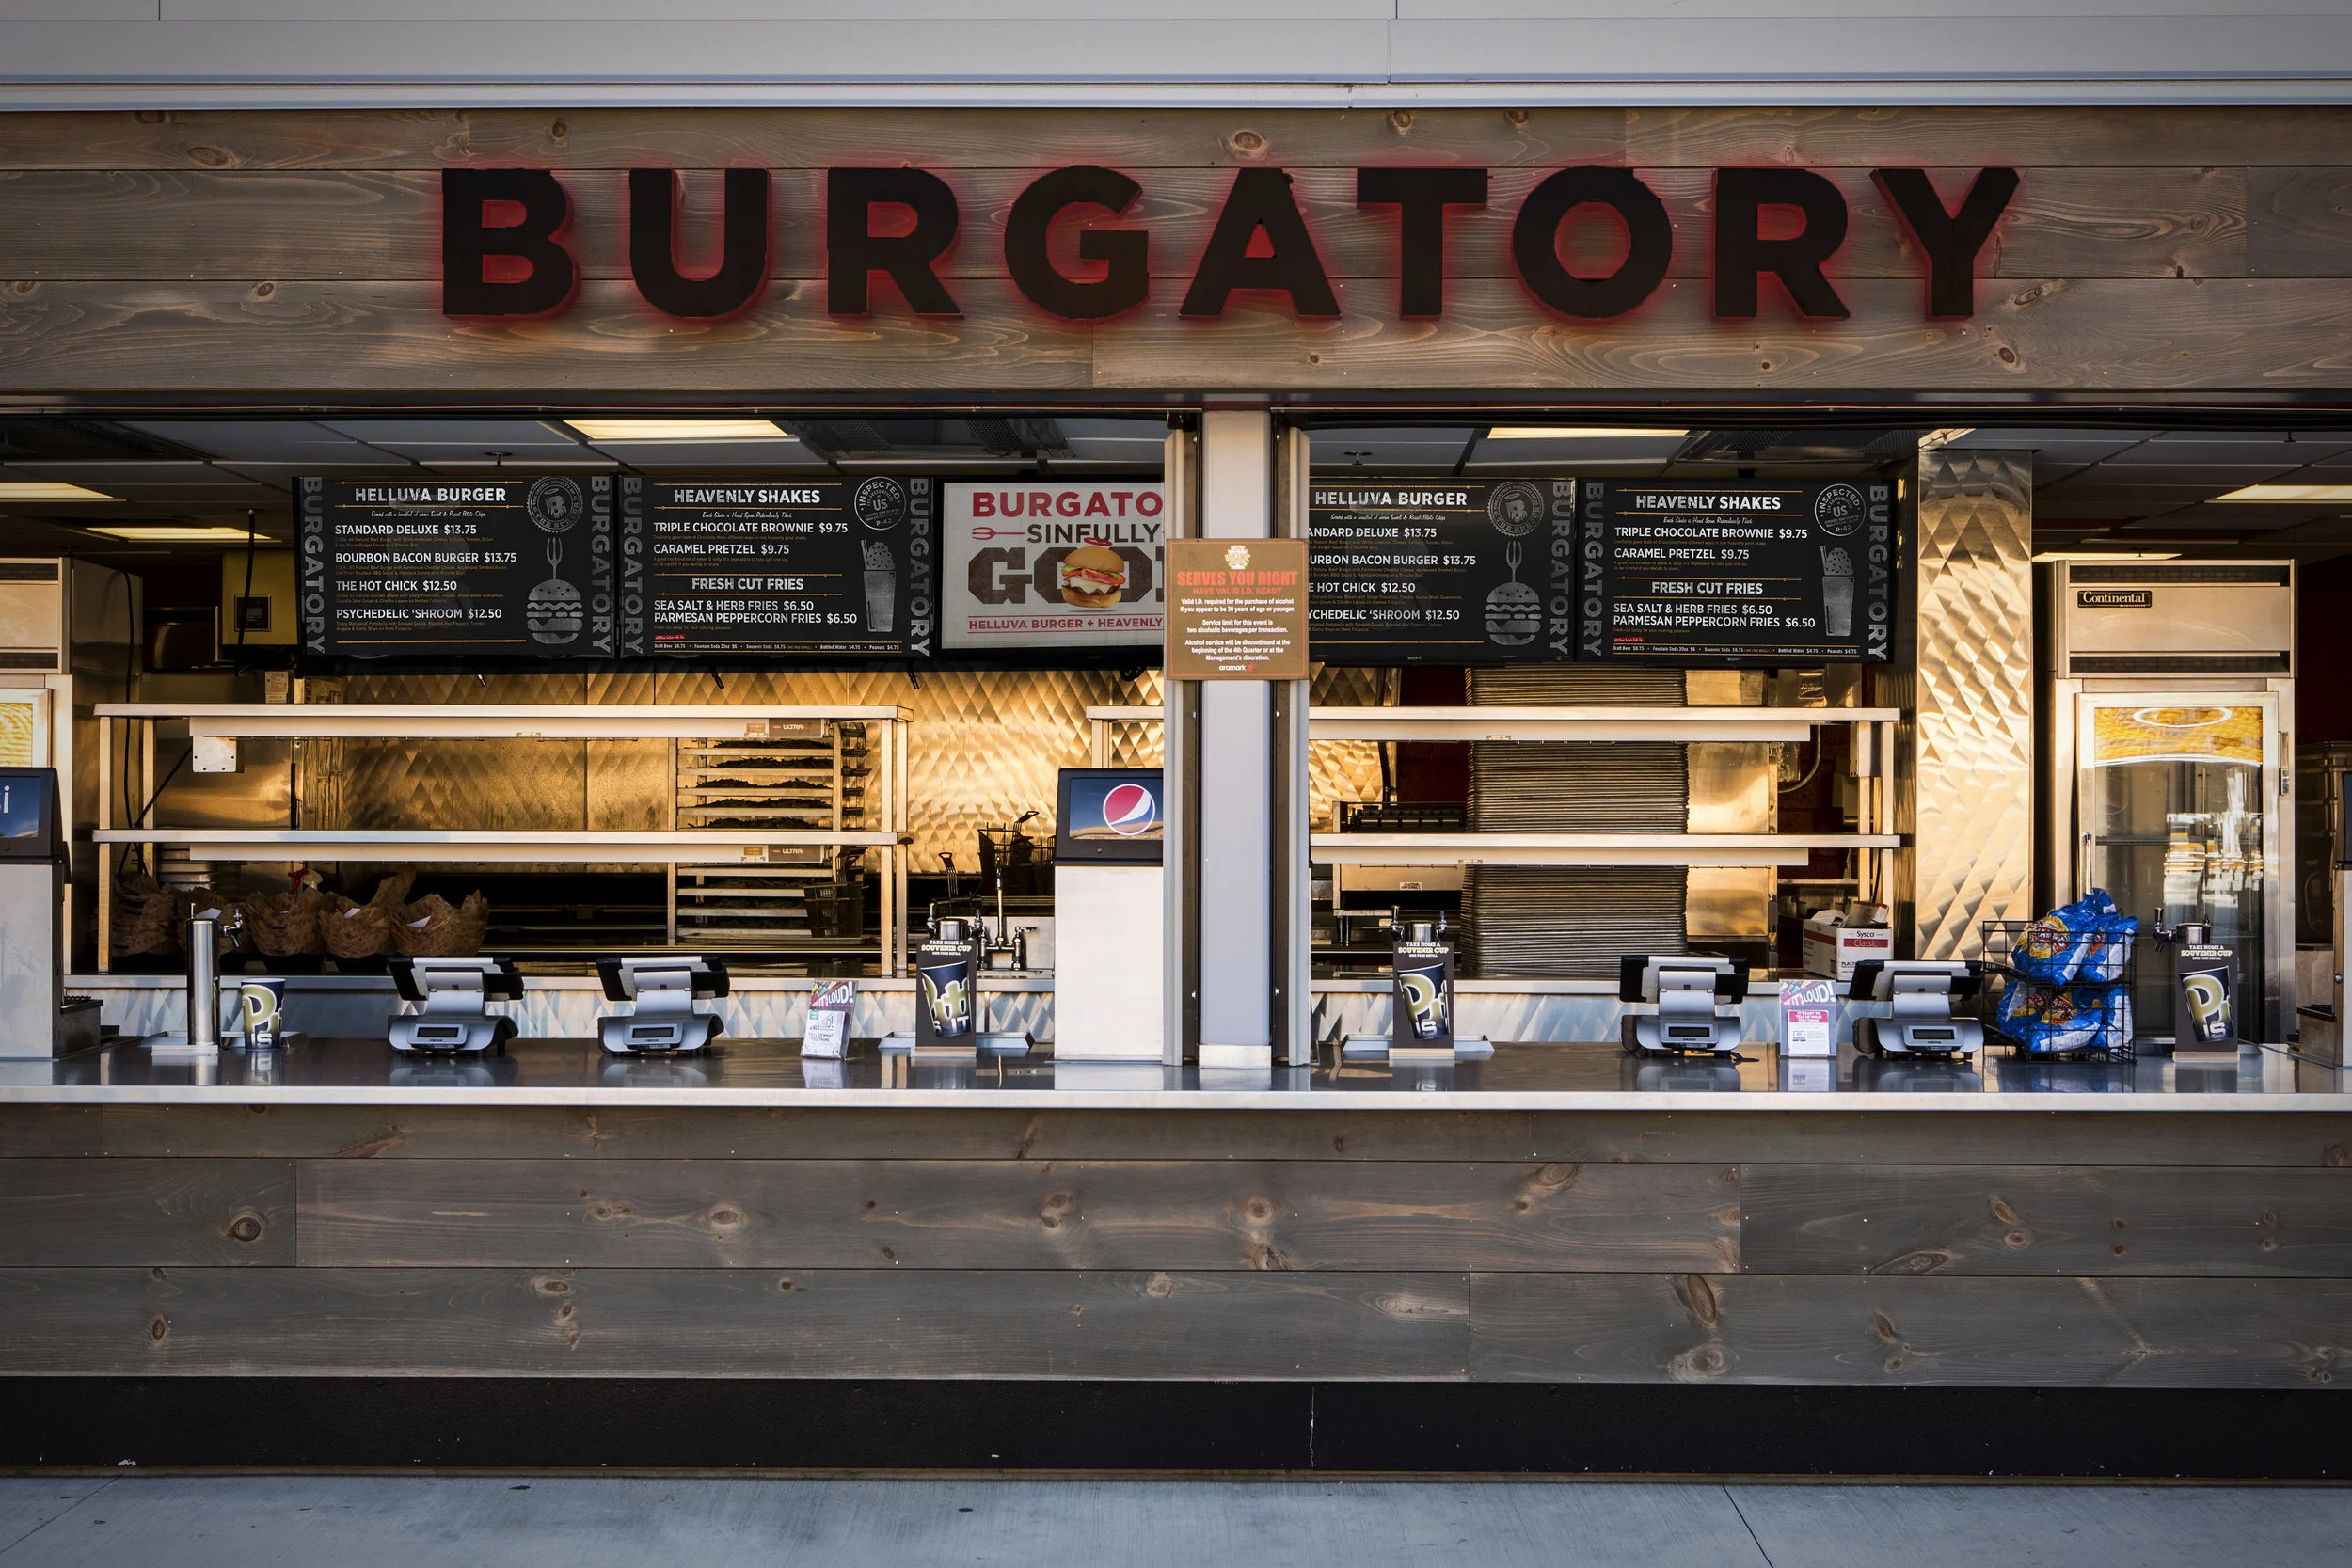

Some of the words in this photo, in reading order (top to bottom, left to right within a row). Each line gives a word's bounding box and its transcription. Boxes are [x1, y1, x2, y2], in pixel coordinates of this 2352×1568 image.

[441, 166, 2019, 321] BURGATORY
[355, 488, 431, 503] HELLUVA
[437, 487, 506, 501] BURGER
[675, 489, 755, 503] HEAVENLY
[758, 489, 820, 503] SHAKES
[859, 481, 900, 506] INSPECTED
[1315, 492, 1391, 506] HELLUVA
[1398, 492, 1467, 505] BURGER
[872, 499, 888, 511] US
[972, 491, 1163, 517] BURGATO
[1636, 495, 1716, 509] HEAVENLY
[1720, 496, 1781, 510] SHAKES
[1820, 488, 1860, 513] INSPECTED
[1833, 505, 1848, 517] US
[335, 525, 394, 534] STANDARD
[397, 525, 439, 534] DELUXE
[444, 524, 477, 535] $13.75
[654, 522, 691, 532] TRIPLE
[692, 522, 758, 532] CHOCOLATE
[761, 522, 814, 532] BROWNIE
[819, 522, 848, 533] $9.75
[1026, 523, 1161, 544] SINFULLY
[1309, 528, 1353, 537] ANDARD
[1356, 528, 1399, 537] DELUXE
[1404, 527, 1437, 539] $13.75
[1614, 527, 1651, 537] TRIPLE
[1654, 527, 1719, 538] CHOCOLATE
[1722, 528, 1774, 538] BROWNIE
[1779, 528, 1807, 540] $9.75
[654, 544, 706, 554] CARAMEL
[708, 544, 755, 554] PRETZEL
[761, 544, 789, 555] $9.75
[1614, 547, 1666, 559] CARAMEL
[1669, 548, 1716, 559] PRETZEL
[1721, 548, 1750, 560] $9.75
[336, 552, 390, 562] BOURBON
[393, 552, 432, 562] BACON
[435, 552, 479, 562] BURGER
[485, 552, 516, 563] $13.75
[1310, 555, 1349, 564] URBON
[1352, 555, 1391, 565] BACON
[1393, 555, 1438, 565] BURGER
[1443, 555, 1476, 566] $13.75
[303, 477, 326, 655] BURGATORY
[591, 476, 612, 654] BURGATORY
[623, 477, 644, 655] BURGATORY
[909, 478, 930, 657] BURGATORY
[1549, 481, 1570, 655] BURGATORY
[1584, 483, 1604, 657] BURGATORY
[1177, 571, 1226, 586] SERVES
[1229, 571, 1255, 585] YOU
[1258, 571, 1297, 585] RIGHT
[1867, 485, 1888, 661] BURGATORY
[336, 581, 357, 591] THE
[359, 580, 382, 591] HOT
[385, 580, 418, 591] CHICK
[423, 580, 457, 592] $12.50
[692, 578, 734, 590] FRESH
[738, 578, 764, 590] CUT
[767, 578, 804, 590] FRIES
[1317, 582, 1340, 593] HOT
[1343, 582, 1376, 593] CHICK
[1381, 582, 1416, 594] $12.50
[1652, 581, 1693, 594] FRESH
[1697, 582, 1723, 594] CUT
[1726, 582, 1763, 594] FRIES
[2083, 591, 2145, 603] Continental
[655, 600, 675, 610] SEA
[677, 600, 704, 610] SALT
[706, 600, 713, 610] &
[716, 600, 745, 610] HERB
[748, 600, 778, 610] FRIES
[784, 600, 814, 611] $6.50
[1614, 604, 1634, 613] SEA
[1637, 603, 1663, 613] SALT
[1665, 603, 1673, 613] &
[1676, 604, 1705, 614] HERB
[1707, 604, 1738, 614] FRIES
[1742, 604, 1772, 615] $6.50
[337, 609, 409, 619] PSYCHEDELIC
[468, 608, 502, 620] $12.50
[655, 612, 713, 623] PARMESAN
[716, 612, 788, 623] PEPPERCORN
[791, 613, 822, 624] FRIES
[827, 612, 857, 625] $6.50
[1309, 610, 1367, 620] YCHEDELIC
[1425, 610, 1460, 621] $12.50
[969, 620, 1027, 629] HELLUVA
[1031, 619, 1084, 628] BURGER
[1098, 617, 1163, 627] HEAVENLY
[1613, 615, 1672, 626] PARMESAN
[1676, 616, 1747, 627] PEPPERCORN
[1750, 617, 1780, 627] FRIES
[1786, 617, 1816, 628] $6.50
[1853, 939, 1878, 947] Classic
[828, 981, 854, 1004] LOUD!
[1803, 981, 1836, 1003] LOUD!
